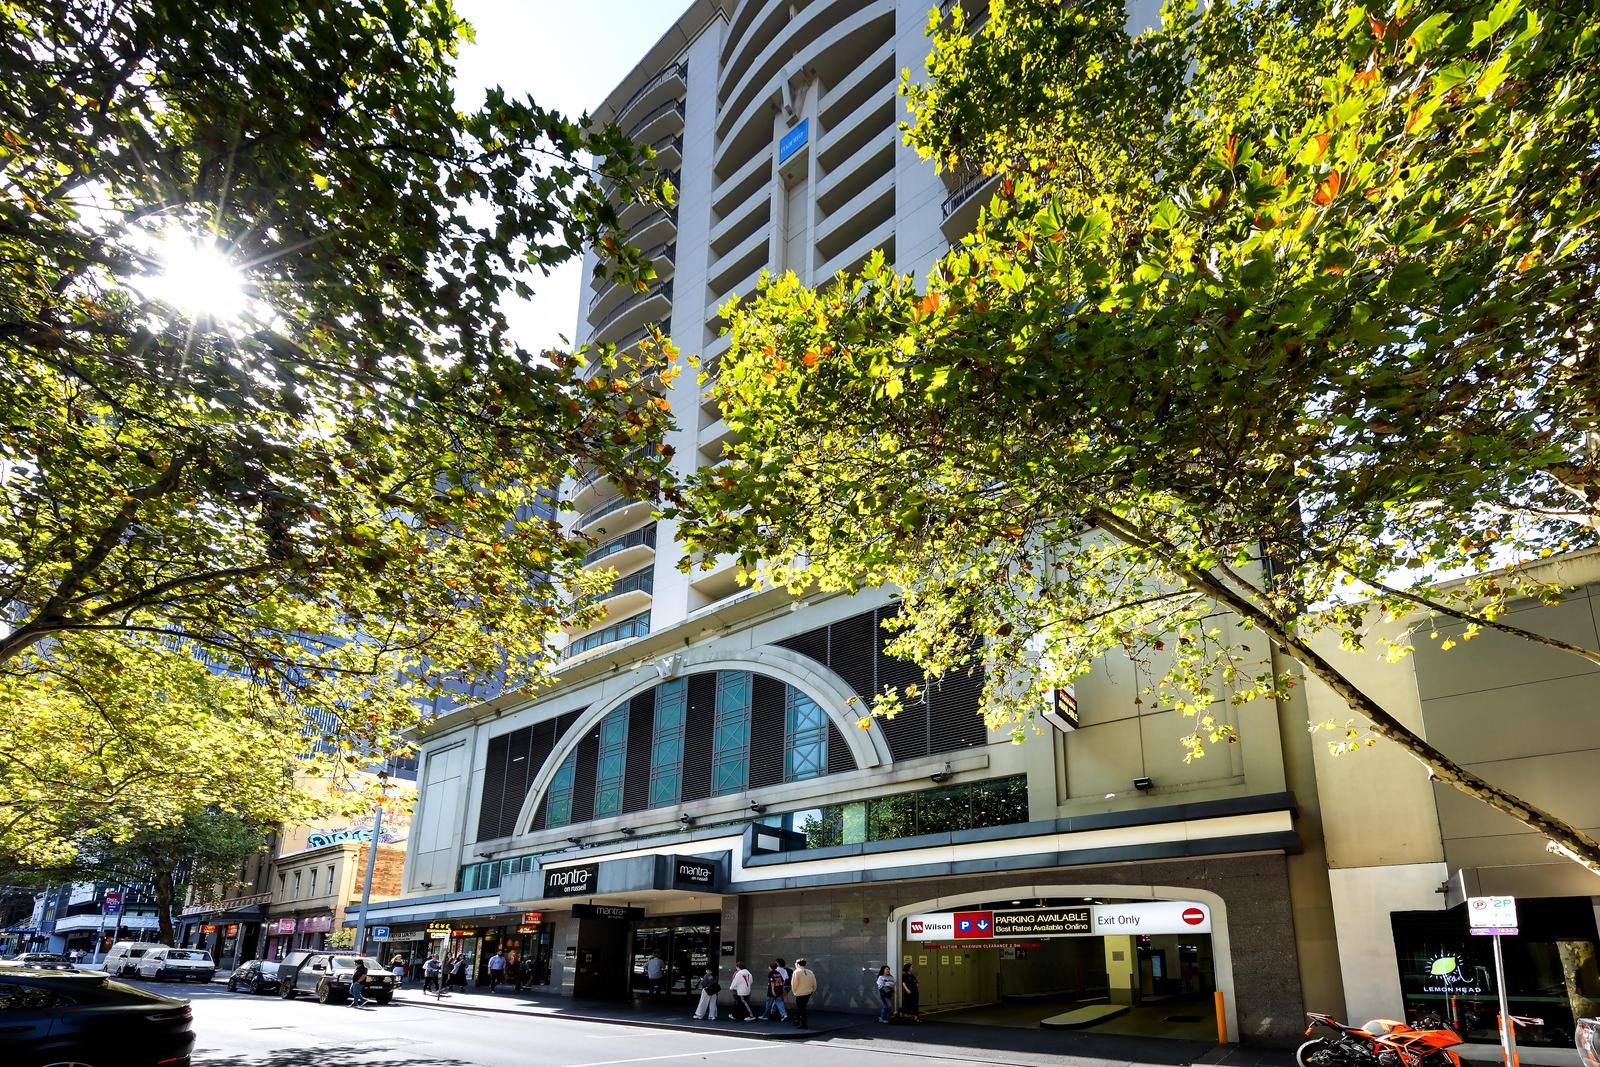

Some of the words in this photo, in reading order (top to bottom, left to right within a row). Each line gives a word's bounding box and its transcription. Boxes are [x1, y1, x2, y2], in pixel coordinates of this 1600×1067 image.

[680, 865, 711, 877] mantra
[549, 869, 592, 886] mantra
[571, 884, 587, 892] russell
[1494, 899, 1512, 907] 2P
[596, 907, 626, 915] mantra
[995, 915, 1035, 924] PARKING
[1036, 912, 1088, 922] AVAILABLE
[1097, 915, 1115, 925] Exit
[1117, 915, 1140, 926] Only
[961, 921, 970, 930] P
